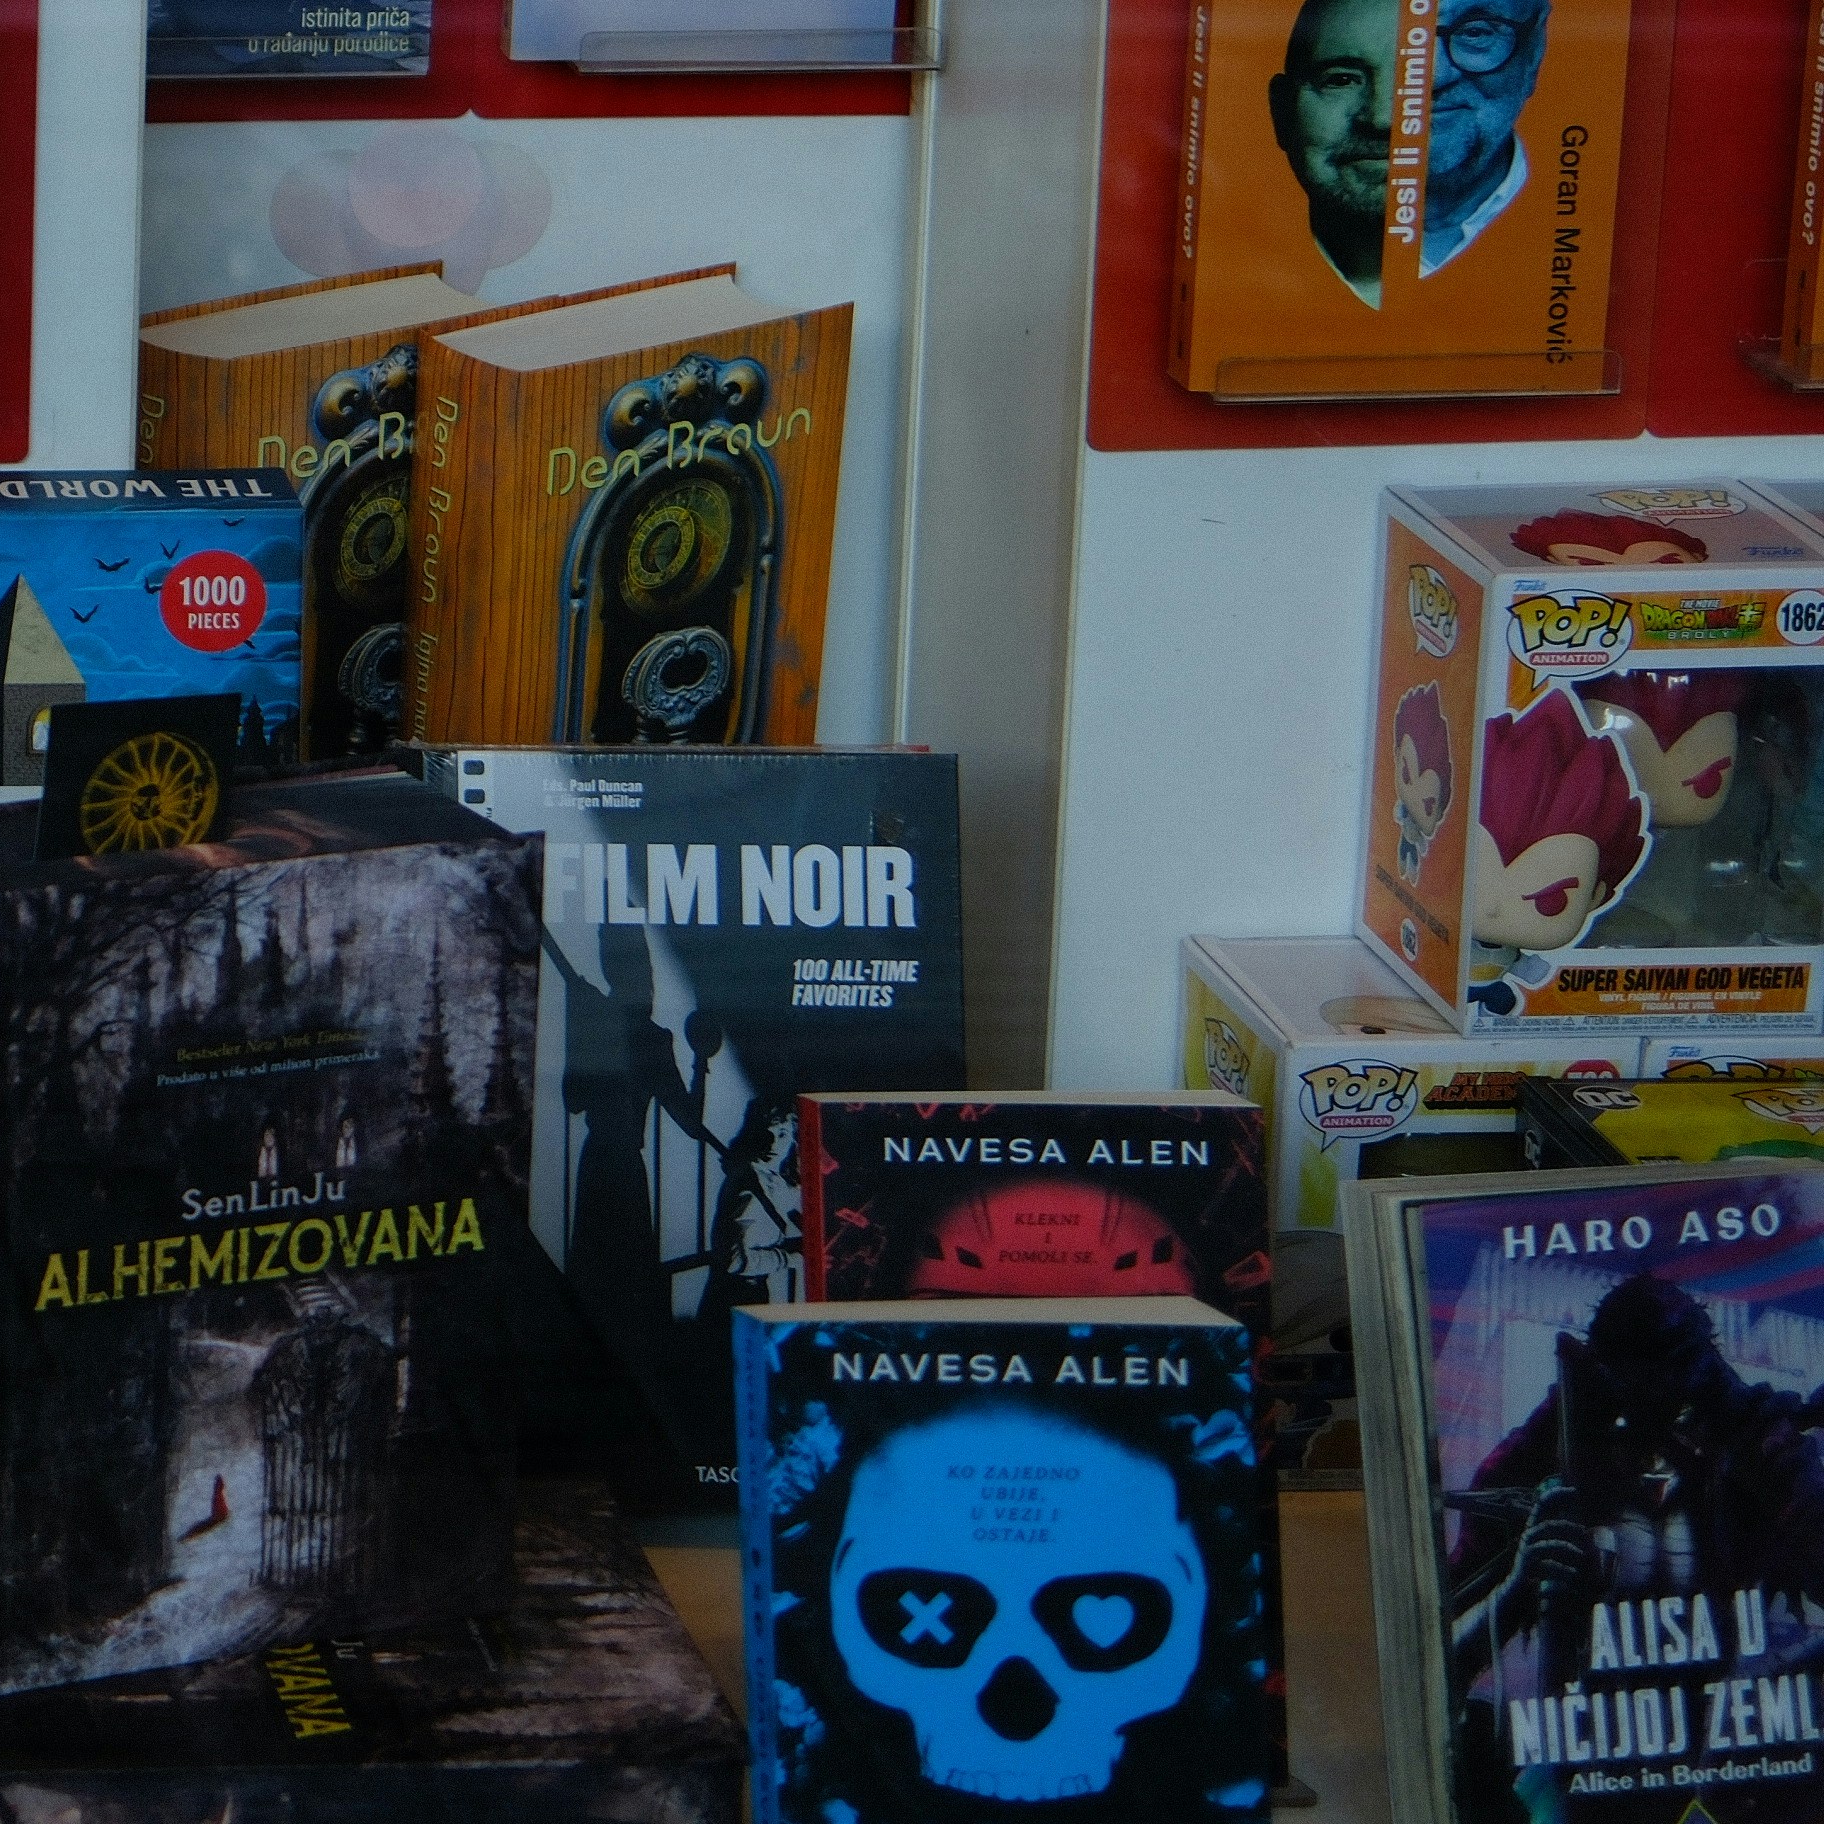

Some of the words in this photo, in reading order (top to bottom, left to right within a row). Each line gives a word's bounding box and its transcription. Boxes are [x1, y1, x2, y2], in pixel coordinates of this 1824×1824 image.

[1400, 28, 1427, 139] snimio
[1394, 149, 1419, 169] li
[1556, 125, 1588, 216] Goran
[1389, 178, 1417, 243] Jesi
[1546, 228, 1580, 363] Marković
[546, 447, 642, 496] Den
[666, 407, 811, 469] Braun
[2, 478, 164, 500] WORLD
[180, 478, 272, 498] THE
[180, 576, 246, 606] 1000
[188, 612, 240, 631] PIECES
[561, 794, 601, 810] Jürgen
[605, 793, 642, 808] Müller
[570, 780, 594, 792] Paul
[598, 780, 643, 792] Duncan
[544, 844, 718, 925] FILM
[742, 844, 916, 926] NOIR
[794, 960, 828, 981] 100
[832, 960, 918, 982] ALL-TIME
[1558, 968, 1619, 992] SUPER
[1624, 968, 1690, 991] SAIYAN
[1695, 967, 1733, 990] GOD
[1739, 965, 1807, 989] VEGETA
[792, 985, 892, 1006] FAVORITES
[182, 1174, 346, 1222] SenLinJu
[1503, 1215, 1654, 1259] HARO
[1679, 1203, 1782, 1244] ASO
[34, 1194, 484, 1315] ALHEMIZOVANA
[834, 1354, 1032, 1384] NAVESA
[1056, 1356, 1189, 1386] ALEN
[1591, 1593, 1719, 1669] ALISA
[1734, 1588, 1765, 1657] U
[1510, 1681, 1687, 1764] NIČIJOJ
[1705, 1674, 1819, 1749] ZEML
[1570, 1770, 1634, 1792] Alice
